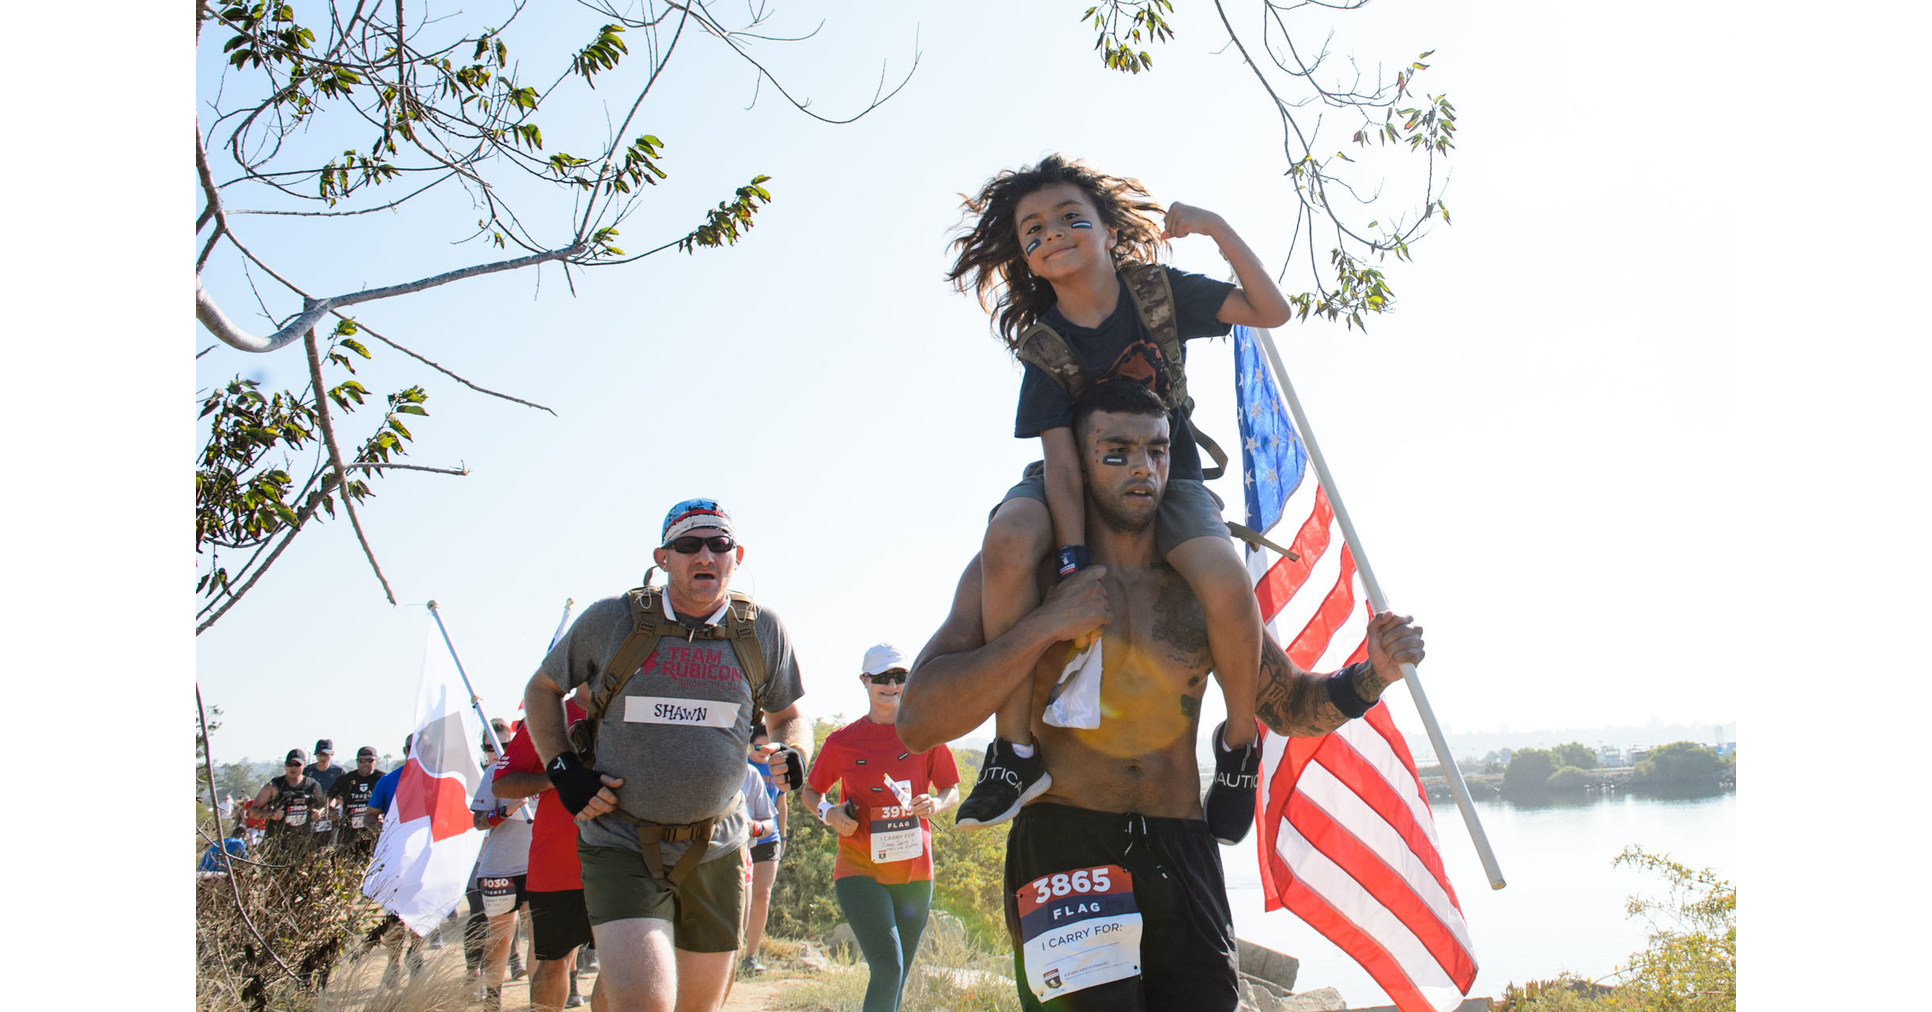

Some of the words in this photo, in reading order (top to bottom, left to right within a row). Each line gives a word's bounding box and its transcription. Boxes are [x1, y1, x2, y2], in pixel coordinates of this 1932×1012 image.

[667, 646, 722, 665] TEAM
[660, 661, 743, 683] RUBICON
[653, 703, 708, 722] SHAWN
[887, 821, 910, 830] FLAG
[1032, 867, 1111, 904] 3865
[1053, 902, 1101, 920] FLAG
[1041, 942, 1045, 951] I
[1048, 928, 1090, 948] CARRY
[1094, 922, 1123, 935] FOR:
